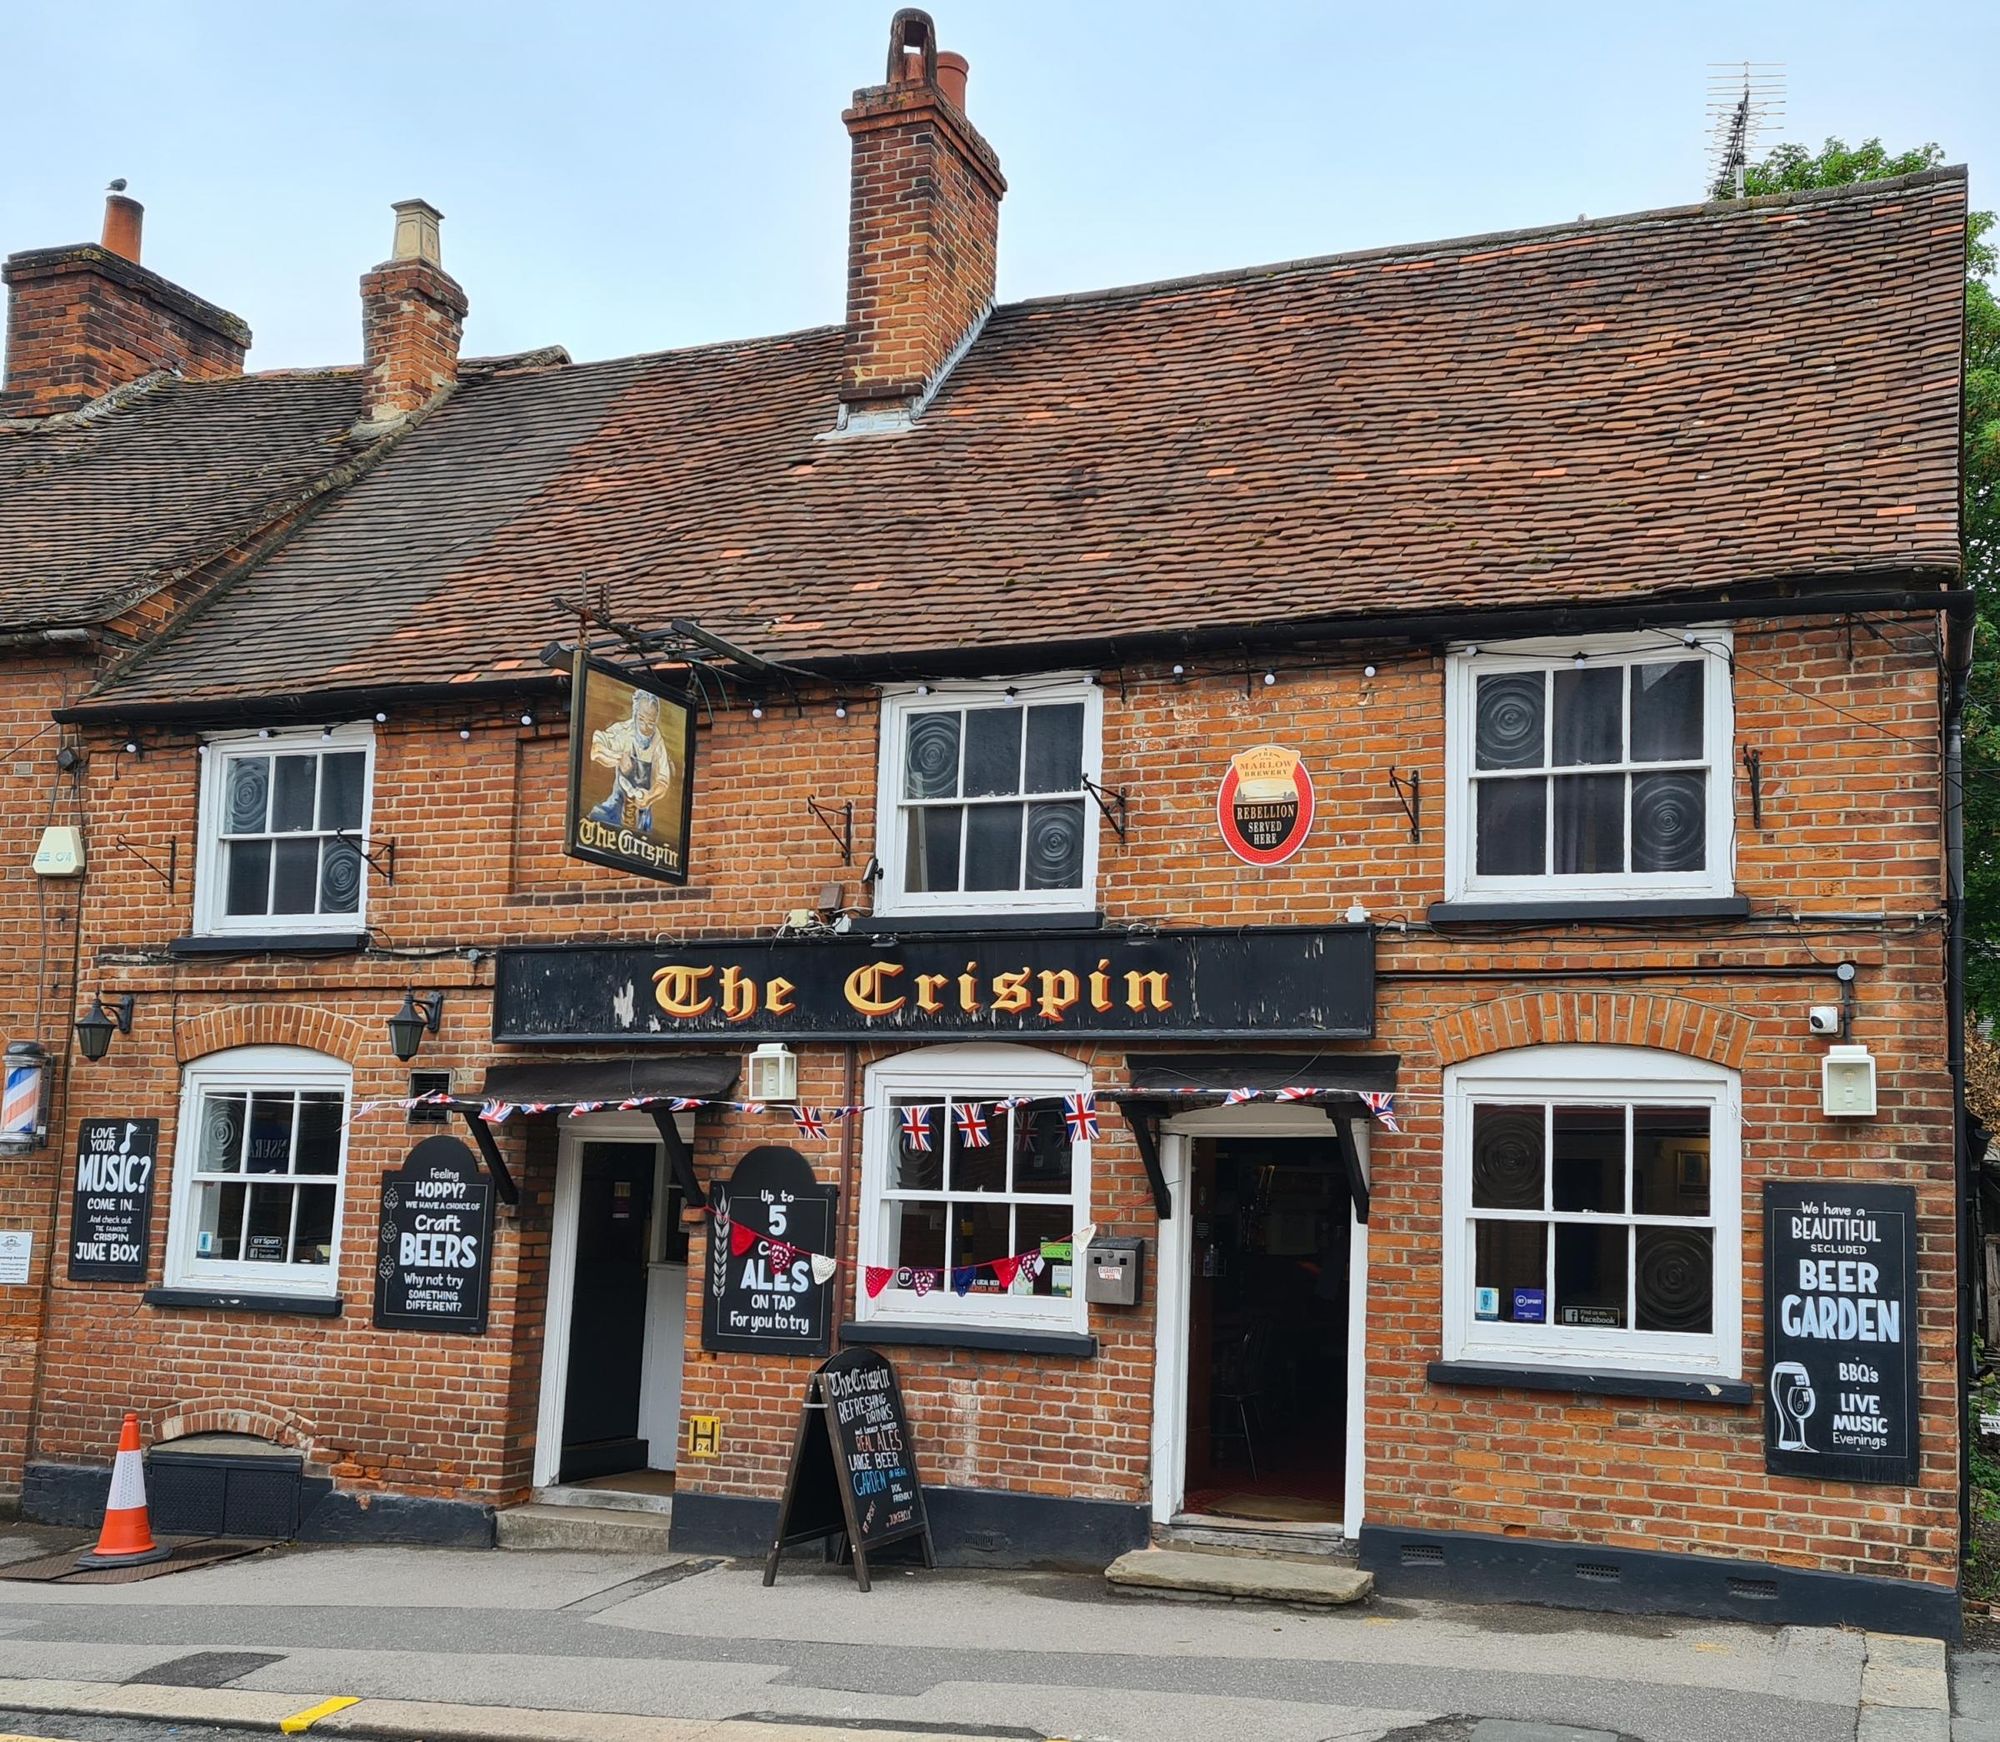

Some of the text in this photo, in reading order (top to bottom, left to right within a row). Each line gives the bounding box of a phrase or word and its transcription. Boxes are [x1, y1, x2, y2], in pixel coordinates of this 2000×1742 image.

[1240, 760, 1293, 771] MARLOW
[1245, 769, 1287, 777] BREWERY
[1237, 804, 1295, 820] REBELLION
[1248, 821, 1282, 833] SERVED
[579, 818, 680, 868] The Crispin
[1253, 833, 1277, 845] HERE
[651, 957, 1174, 1022] The Crispin
[90, 1127, 116, 1139] LOVE
[90, 1139, 115, 1152] YOUR
[77, 1154, 151, 1193] MUSIC?
[430, 1167, 460, 1181] Feeling
[414, 1181, 466, 1199] HOPPY?
[760, 1189, 795, 1204] Up to
[87, 1198, 115, 1210] COME
[405, 1200, 418, 1209] WE
[419, 1201, 439, 1209] HAVE
[446, 1202, 470, 1210] CHOICE
[470, 1203, 480, 1211] OF
[1801, 1201, 1866, 1217] We have a
[102, 1215, 120, 1224] check
[121, 1216, 133, 1224] out
[414, 1214, 461, 1232] Craft
[768, 1204, 787, 1236] 5
[93, 1233, 129, 1242] CRISPIN
[1791, 1216, 1882, 1243] BEAUTIFUL
[263, 1238, 279, 1246] Sport
[399, 1233, 478, 1269] BEERS
[1810, 1244, 1867, 1255] SECLUDED
[75, 1242, 140, 1262] JUKE BOX
[404, 1272, 464, 1290] Why not try
[740, 1258, 810, 1293] ALES
[900, 1272, 910, 1280] BT
[1799, 1258, 1880, 1294] BEER
[408, 1289, 459, 1301] SOMETHING
[751, 1294, 796, 1311] ON TAP
[405, 1300, 462, 1312] DIFFERENT?
[730, 1311, 809, 1333] For you to try
[1580, 1315, 1616, 1325] facebook
[1781, 1294, 1900, 1343] GARDEN
[828, 1365, 890, 1398] The Crispin
[1839, 1362, 1879, 1384] BBQ's
[838, 1393, 887, 1424] REFRESHING
[1840, 1392, 1880, 1415] LIVE
[866, 1403, 893, 1424] DRINKS
[1833, 1414, 1888, 1434] MUSIC
[693, 1420, 715, 1453] H
[855, 1429, 903, 1452] REAL ALES
[1833, 1432, 1887, 1450] Evenings
[698, 1443, 709, 1451] 24
[848, 1451, 900, 1471] LARGE BEER
[853, 1470, 888, 1497] GARDEN
